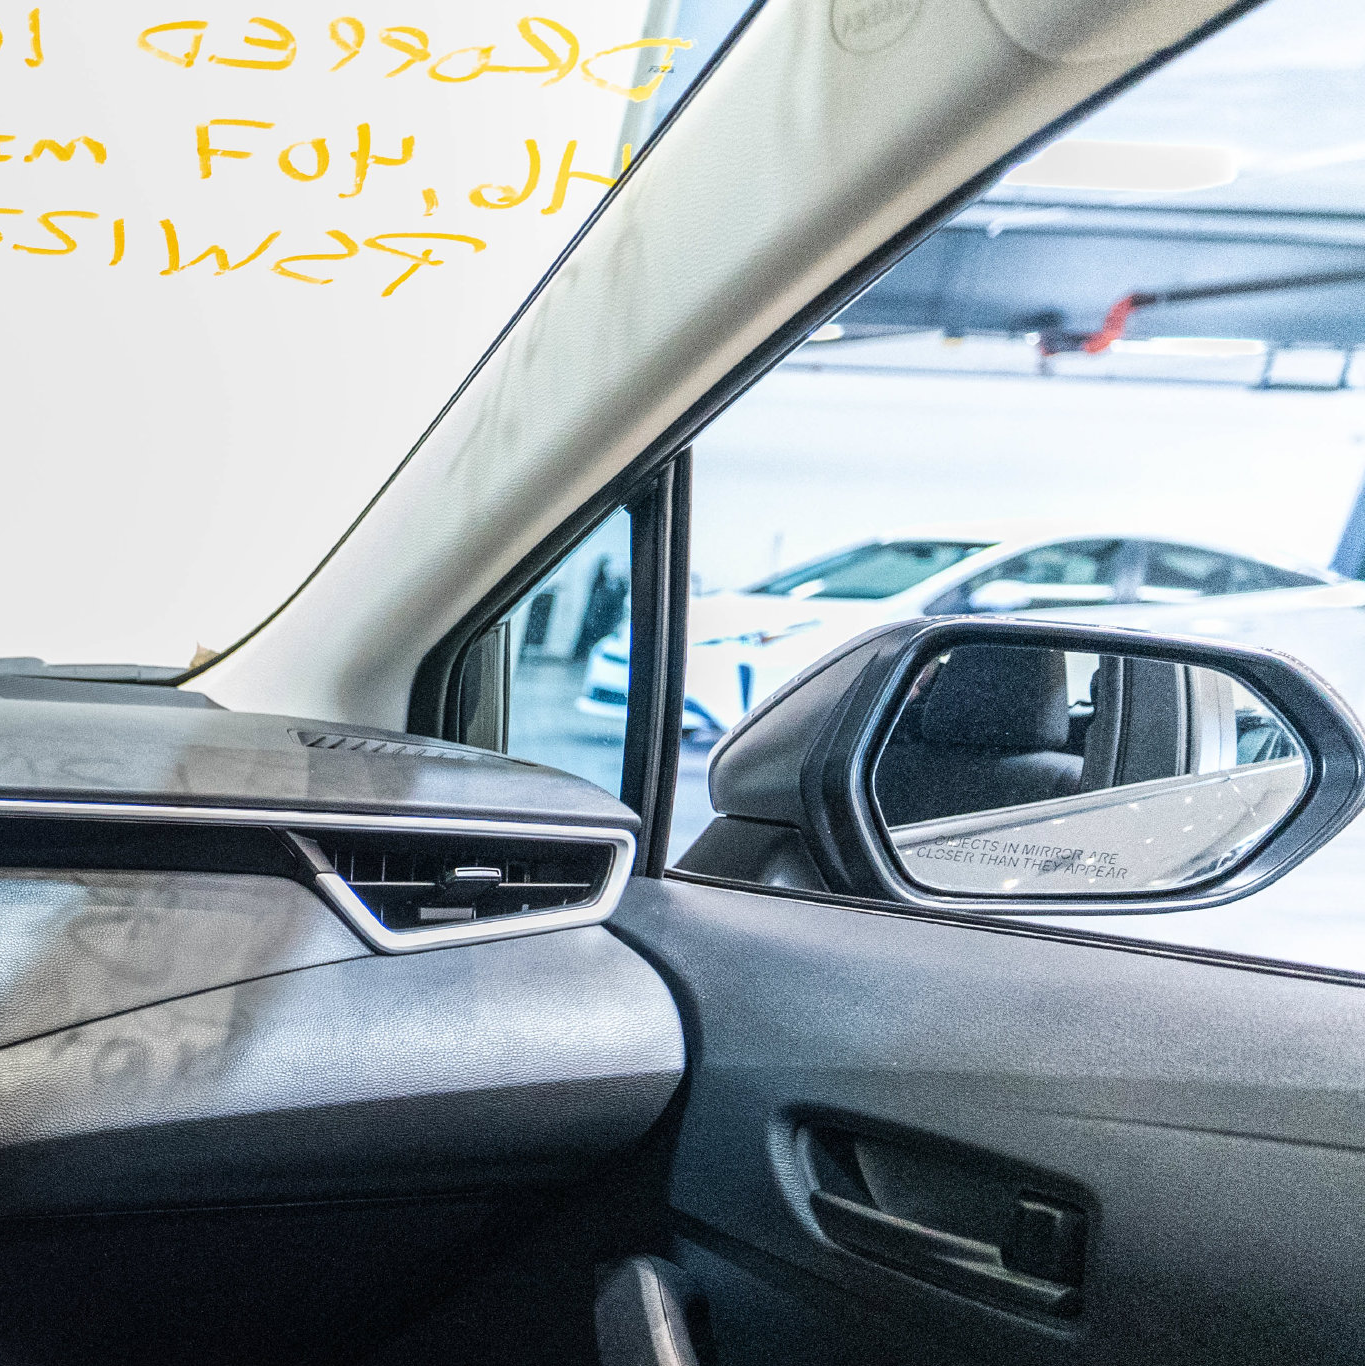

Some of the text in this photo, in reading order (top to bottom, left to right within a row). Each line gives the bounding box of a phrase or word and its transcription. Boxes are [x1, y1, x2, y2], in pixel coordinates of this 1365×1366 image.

[917, 847, 1127, 879] CLOSER THAN THEY APPEAR
[1003, 842, 1019, 855] IN
[1021, 844, 1083, 860] MIRROR
